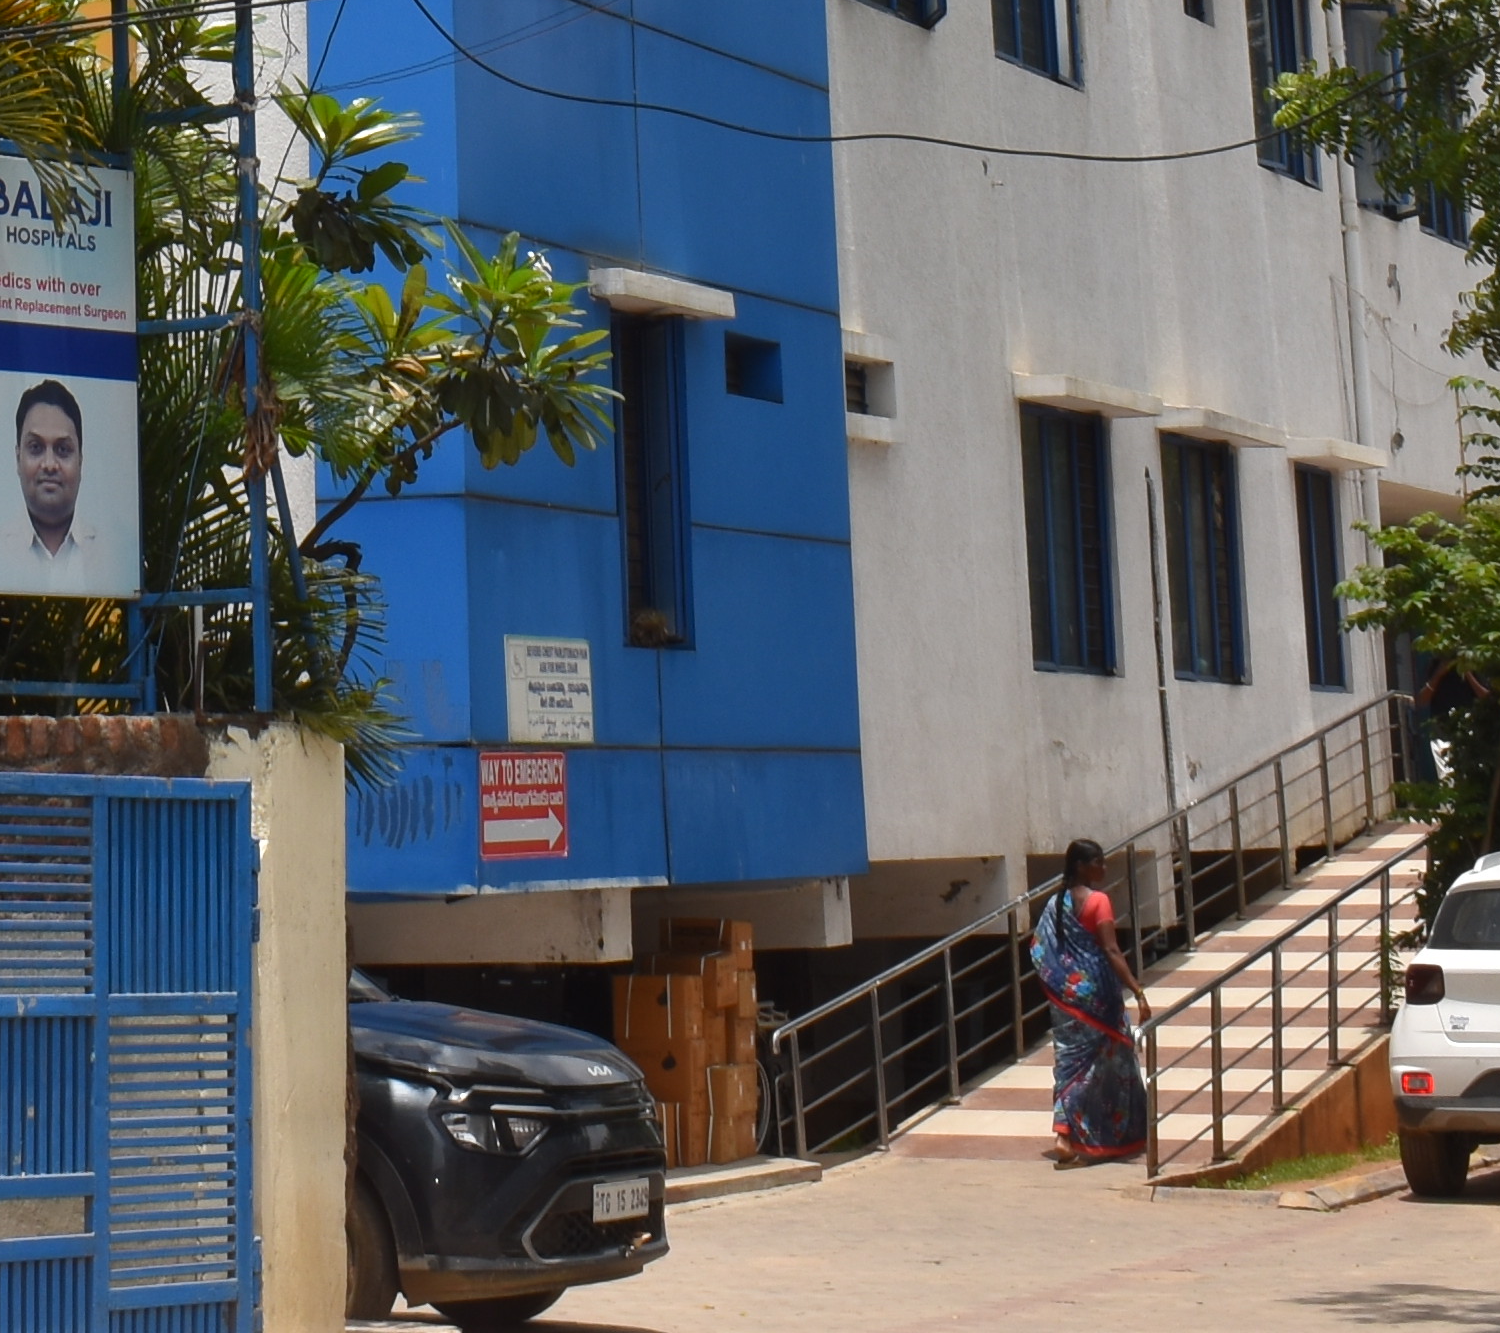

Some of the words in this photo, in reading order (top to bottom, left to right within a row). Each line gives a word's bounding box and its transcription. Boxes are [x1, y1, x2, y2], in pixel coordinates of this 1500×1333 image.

[6, 225, 96, 252] HOSPITALS
[36, 275, 66, 293] with
[70, 282, 101, 297] over
[15, 298, 82, 318] Replacement
[83, 304, 127, 322] Surgeon
[481, 759, 500, 786] WAY
[501, 758, 513, 786] TO
[514, 758, 564, 785] EMERGENCY
[600, 1191, 611, 1214] TG
[616, 1189, 626, 1212] 15
